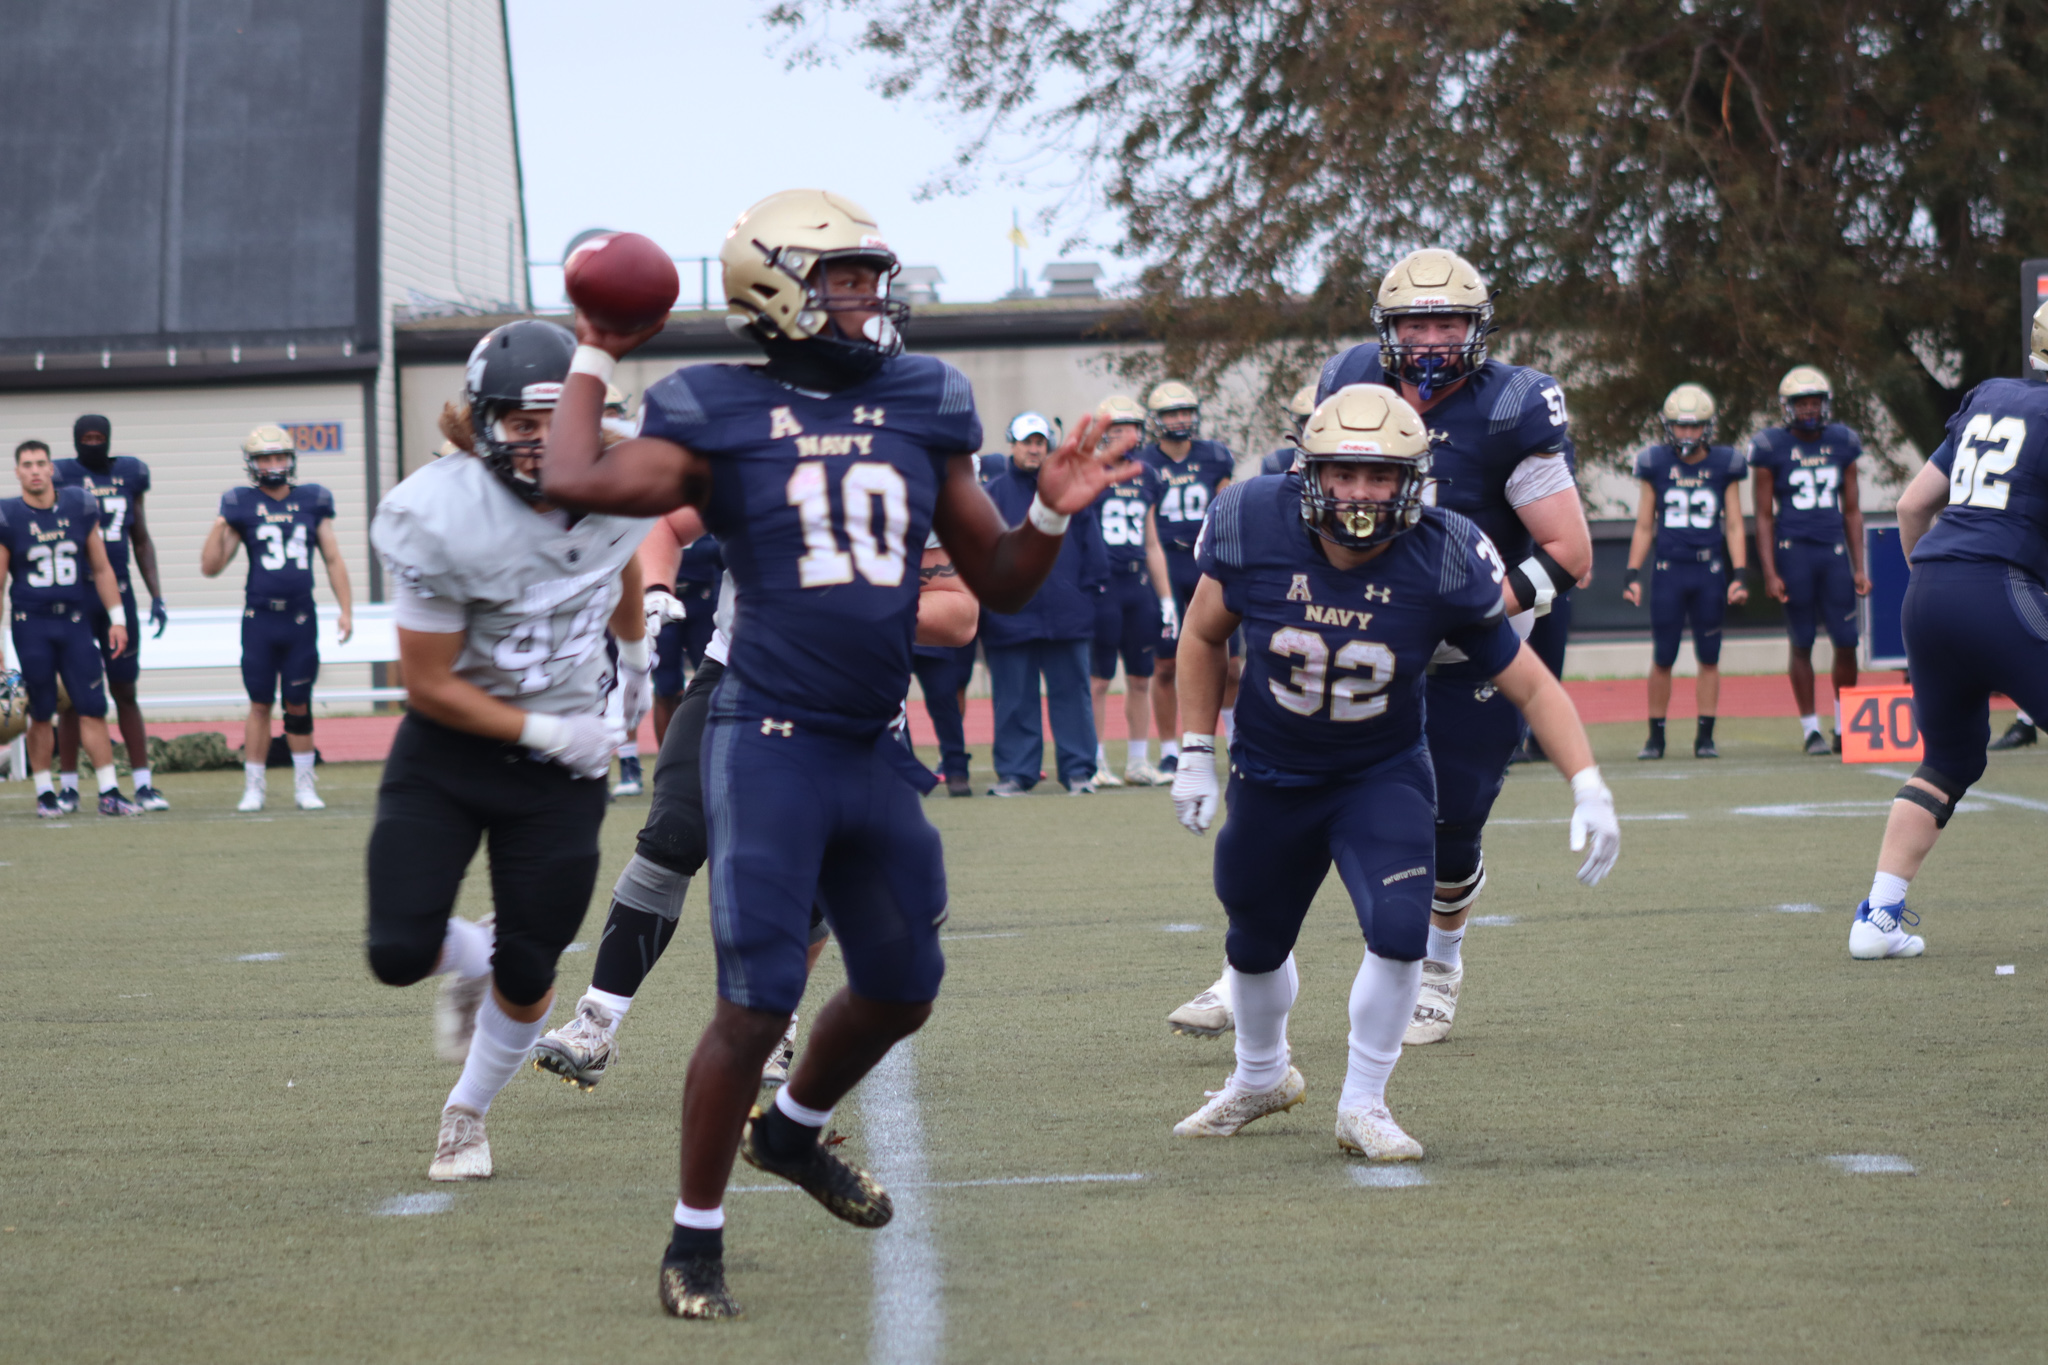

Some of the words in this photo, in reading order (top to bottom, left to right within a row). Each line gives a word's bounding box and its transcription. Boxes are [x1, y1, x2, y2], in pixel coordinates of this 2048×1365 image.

[769, 405, 803, 440] A
[794, 433, 873, 458] NAVY
[1800, 456, 1827, 467] NAVY
[1948, 413, 2026, 510] 62
[90, 486, 118, 497] NAVY
[1114, 487, 1140, 498] NAVY
[1168, 474, 1195, 486] NAVY
[1676, 478, 1704, 488] NAVY
[1788, 466, 1838, 510] 37
[98, 497, 127, 542] 7
[265, 513, 293, 524] NAVY
[1159, 483, 1208, 522] 40
[1663, 488, 1716, 529] 23
[37, 530, 65, 543] NAVY
[786, 460, 911, 588] 10
[27, 540, 78, 588] 36
[256, 524, 309, 571] 34
[1286, 574, 1312, 602] A
[1304, 604, 1373, 630] NAVY
[1268, 626, 1396, 722] 32
[1849, 696, 1919, 750] 40
